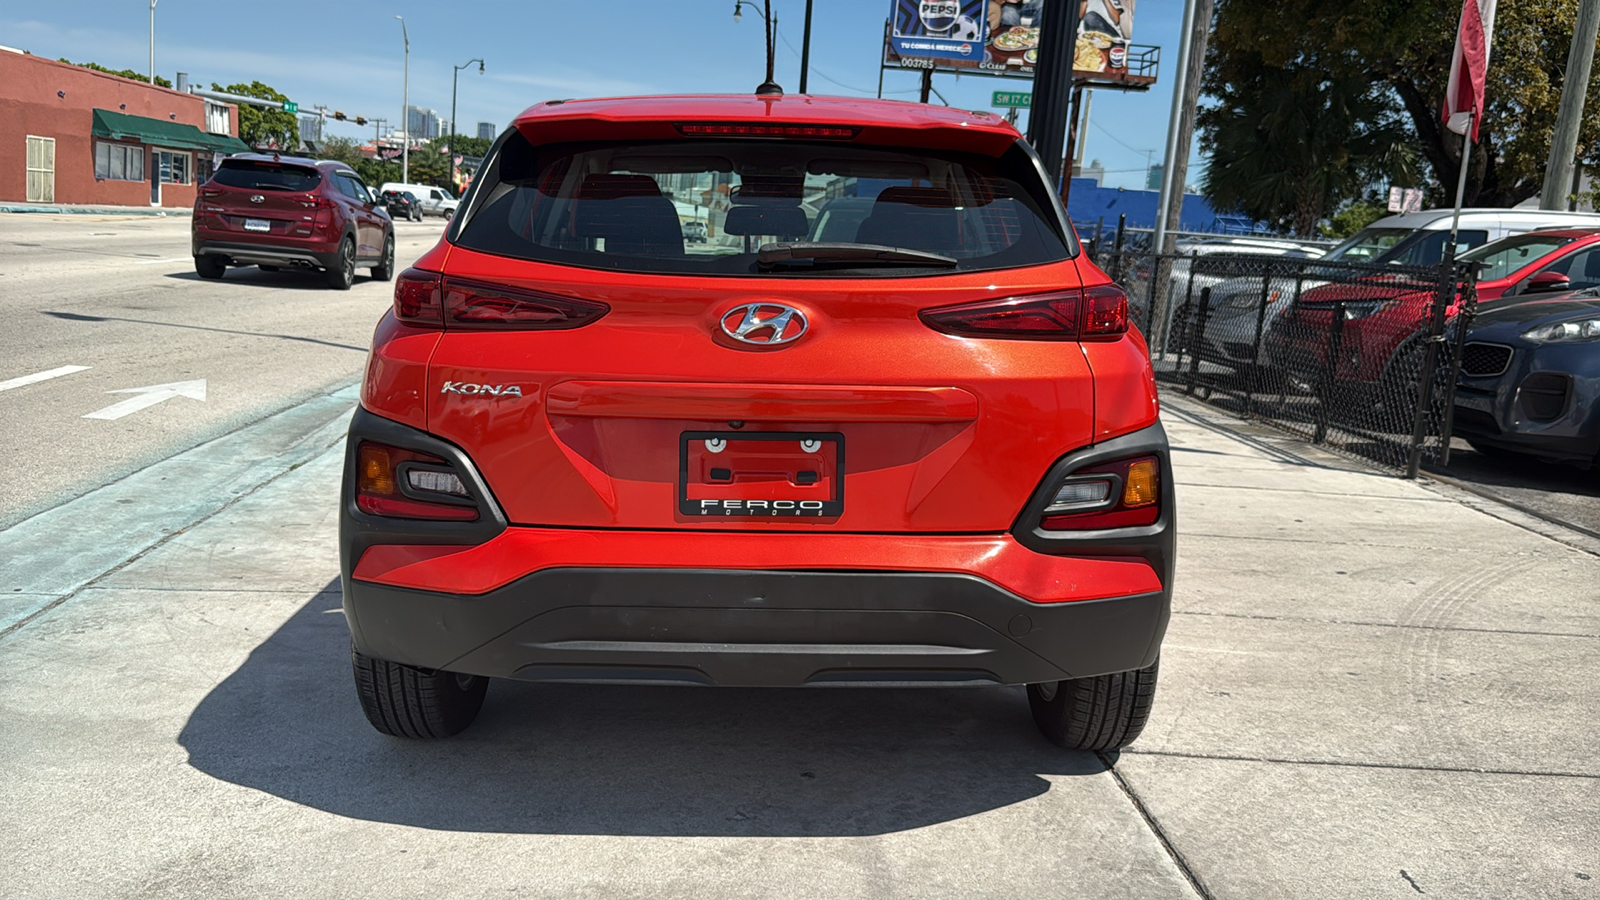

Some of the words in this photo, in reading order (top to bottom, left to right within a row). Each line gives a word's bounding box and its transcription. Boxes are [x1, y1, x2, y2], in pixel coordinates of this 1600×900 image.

[922, 4, 957, 15] PEPSI
[901, 58, 934, 69] 003785
[996, 94, 1010, 104] SW
[1011, 95, 1021, 104] 17
[441, 381, 522, 398] KONA
[701, 500, 823, 509] FERCO
